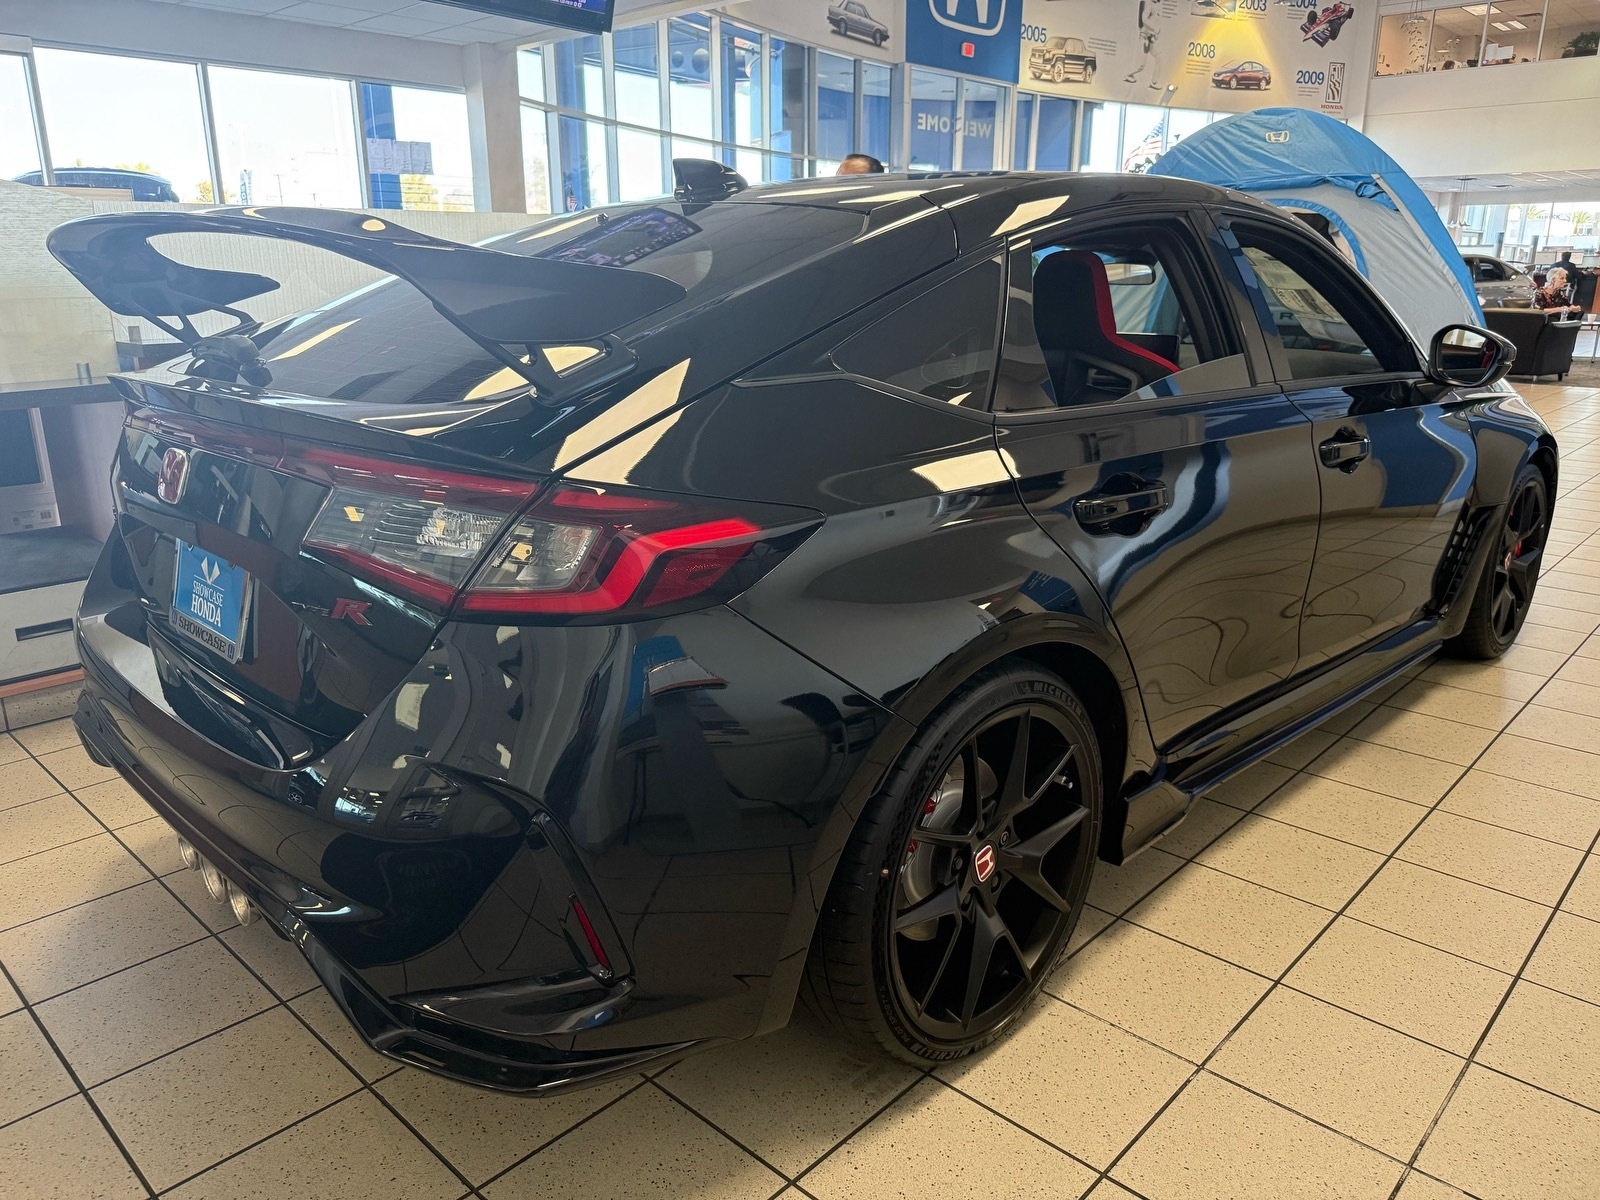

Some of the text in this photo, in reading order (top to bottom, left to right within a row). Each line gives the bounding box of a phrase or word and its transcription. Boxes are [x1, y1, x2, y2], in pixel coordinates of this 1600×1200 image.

[1288, 0, 1318, 10] 004
[1021, 24, 1047, 43] 2005
[1187, 42, 1216, 58] 2008
[1295, 70, 1325, 85] 2009
[193, 580, 224, 607] SHOWCASE
[191, 594, 222, 627] HONDA
[331, 597, 375, 626] R
[178, 615, 227, 653] SHOWCASE
[1033, 682, 1082, 715] MICHELIN
[910, 1042, 972, 1060] MICHELIN
